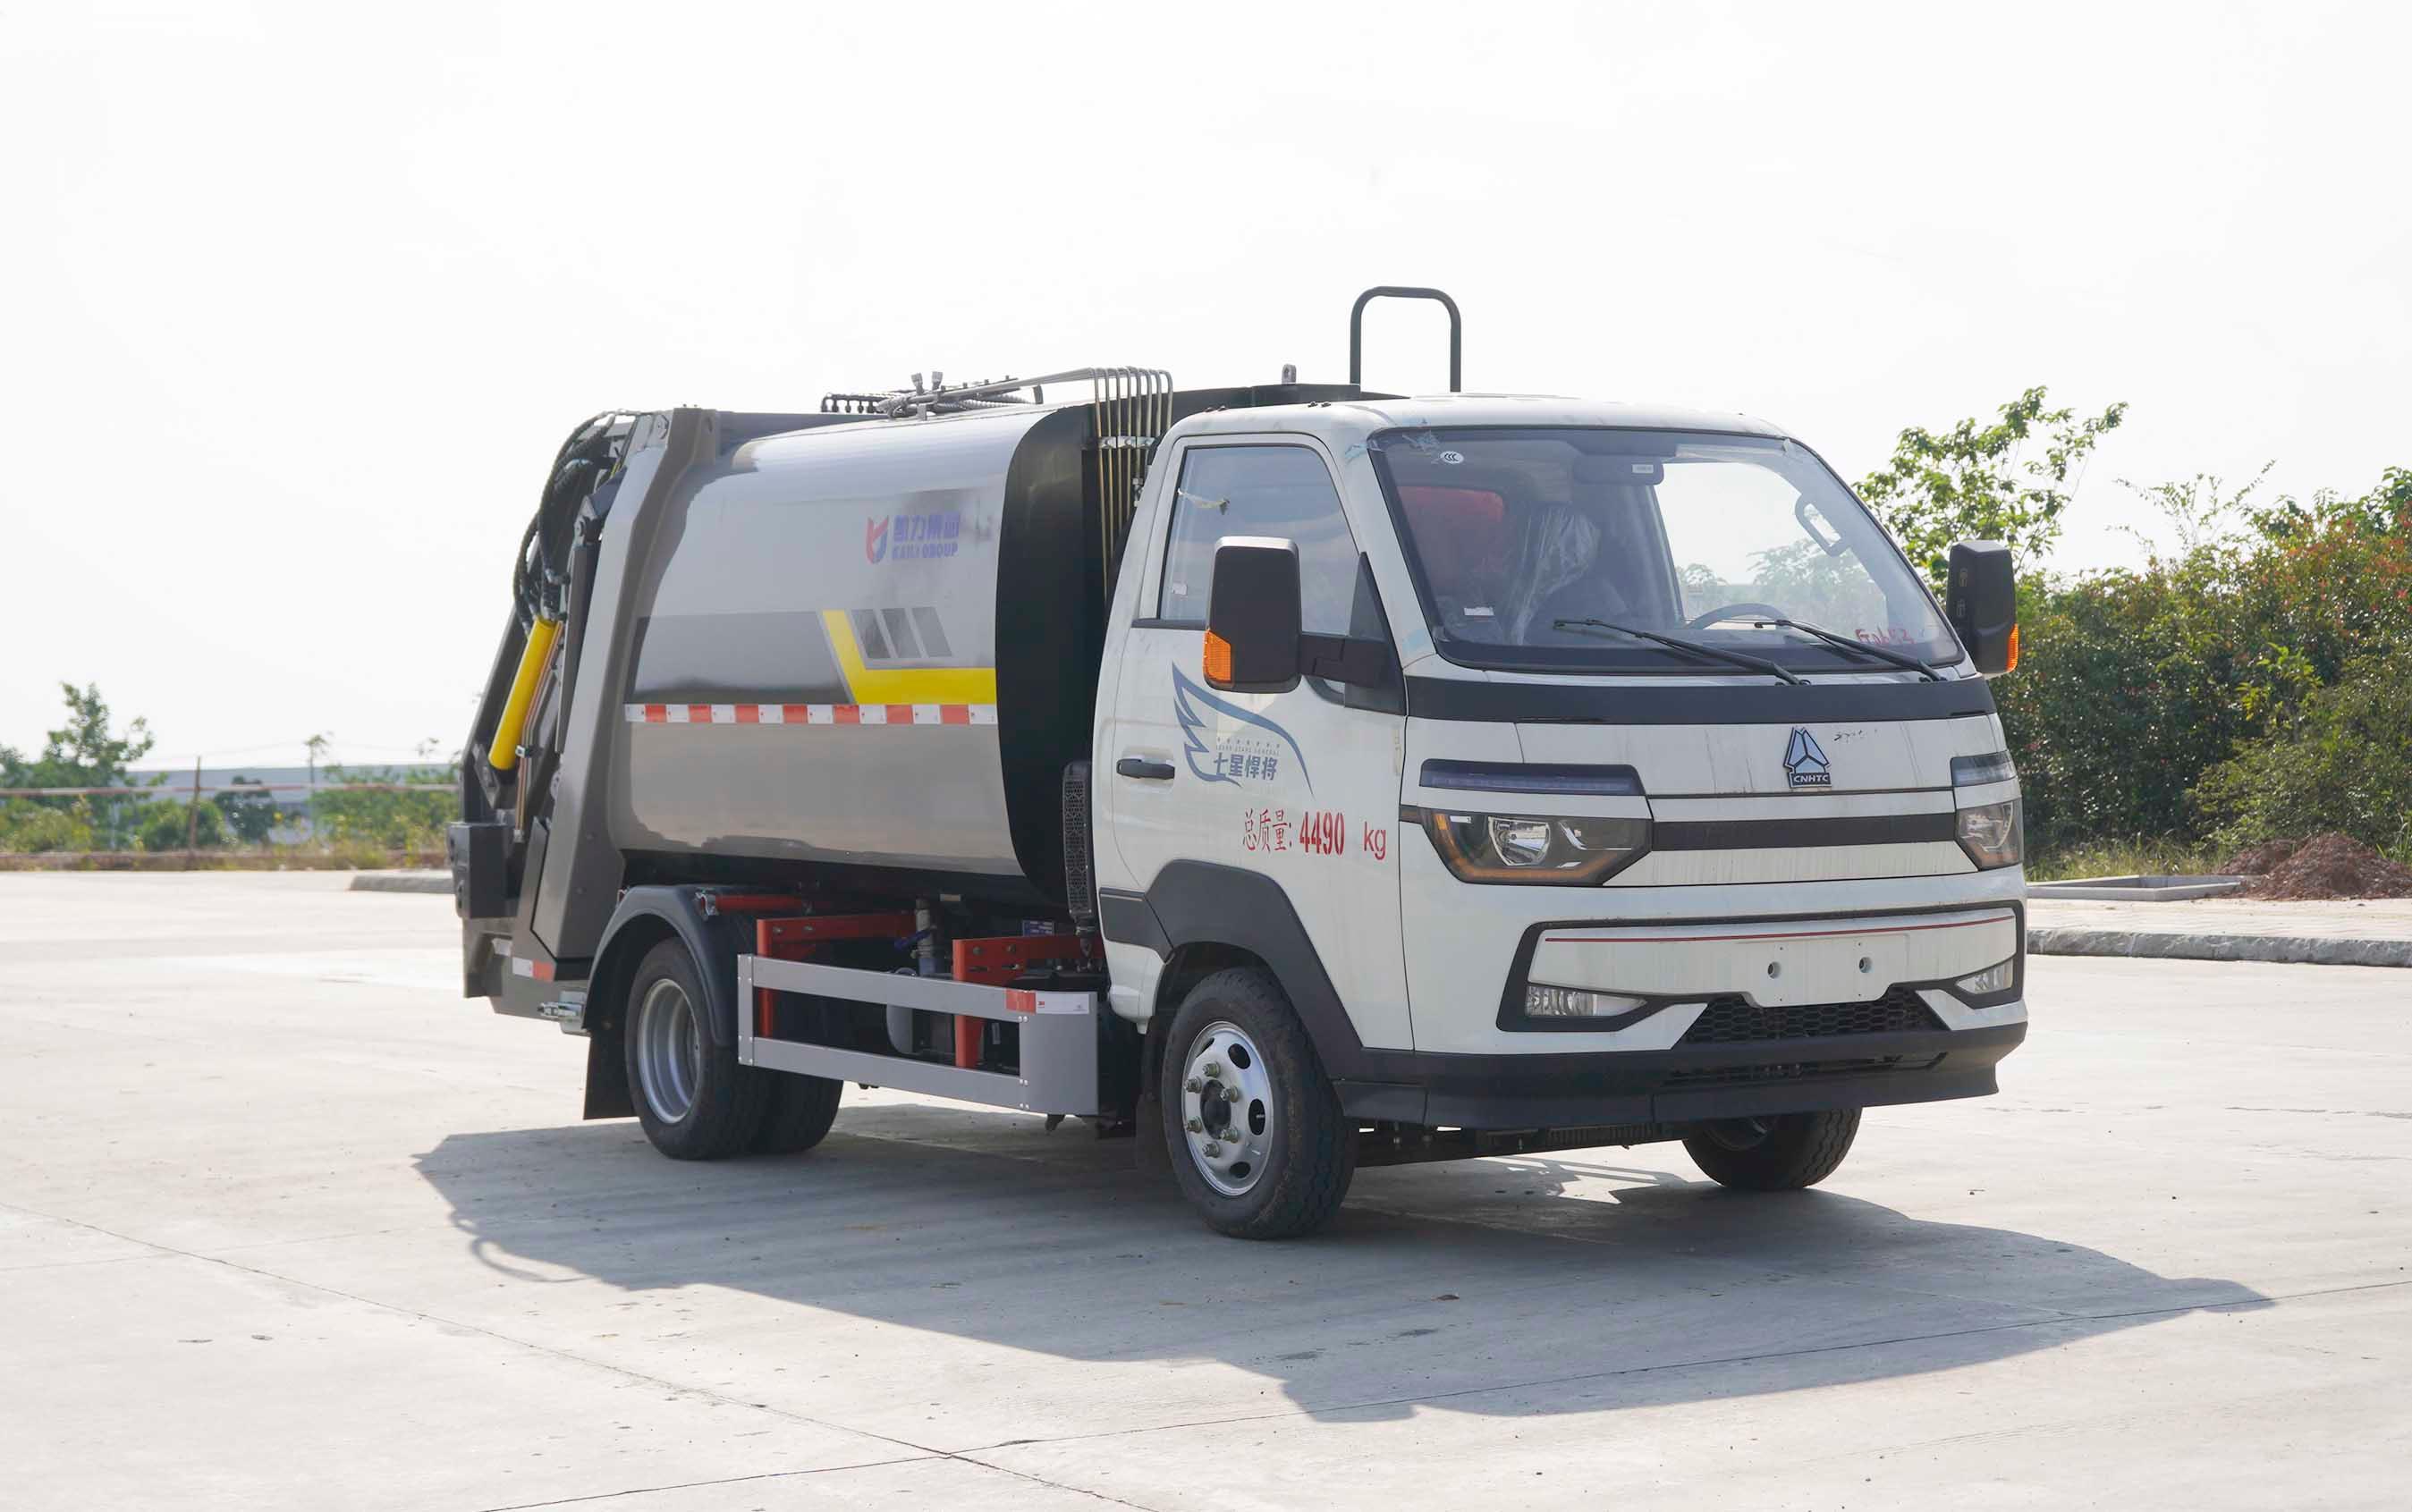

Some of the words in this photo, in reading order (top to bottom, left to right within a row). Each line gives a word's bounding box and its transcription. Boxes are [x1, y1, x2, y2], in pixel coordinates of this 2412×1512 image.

[1793, 774, 1829, 783] CNHTC
[1299, 811, 1345, 855] 4490
[1364, 821, 1387, 860] kg
